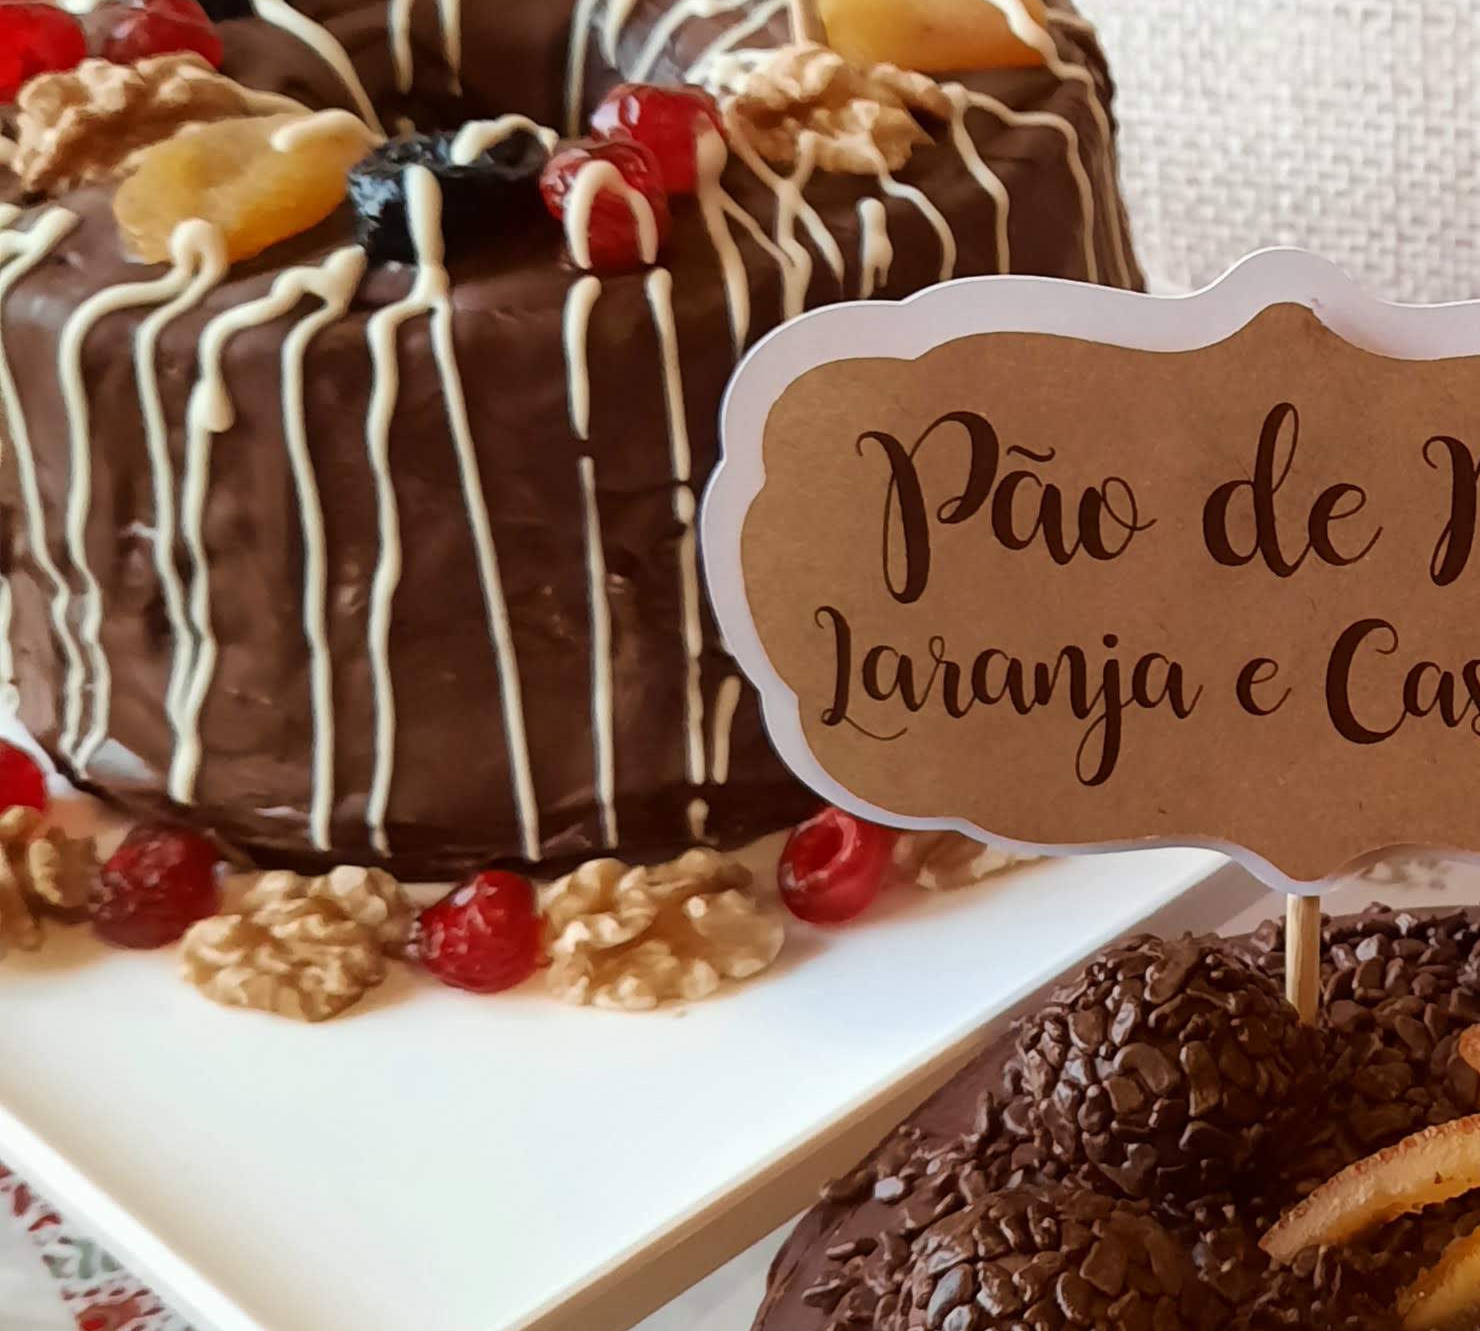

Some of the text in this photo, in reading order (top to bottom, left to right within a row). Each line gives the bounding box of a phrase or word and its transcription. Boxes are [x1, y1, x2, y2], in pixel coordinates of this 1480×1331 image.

[855, 410, 1158, 605] Pão
[1202, 402, 1384, 579] de
[814, 604, 1204, 787] Laranja
[1235, 656, 1293, 717] e
